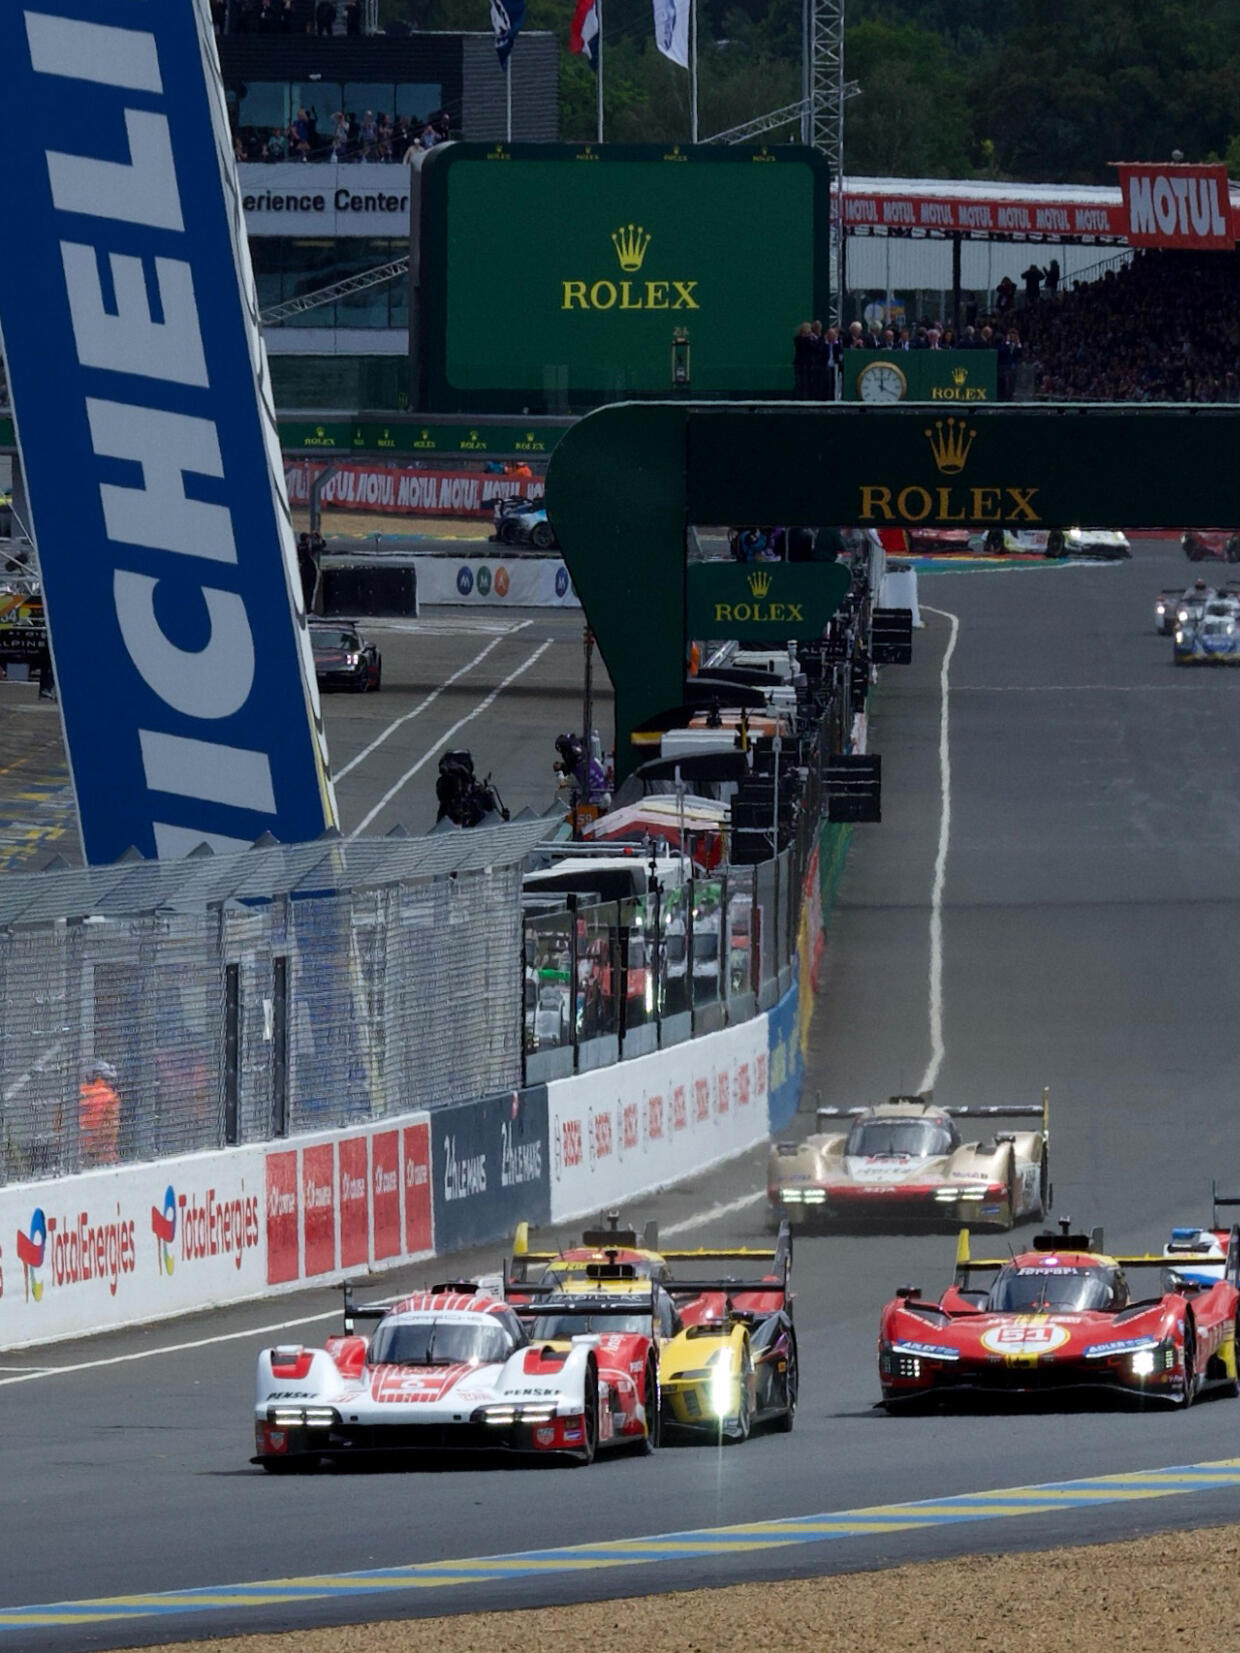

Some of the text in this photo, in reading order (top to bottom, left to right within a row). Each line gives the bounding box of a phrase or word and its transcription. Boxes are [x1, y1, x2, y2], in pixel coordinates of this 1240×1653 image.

[334, 189, 408, 212] Center
[1129, 175, 1226, 238] MOTUL
[845, 200, 1109, 232] MOTUL MOTUL MOTUL MOTUL MOTUL MOTUL MOTUL
[562, 280, 699, 310] ROLEX
[932, 386, 987, 400] ROLEX
[398, 475, 437, 509] MOTUL
[440, 477, 481, 510] MOTUL
[857, 486, 1040, 520] ROLEX
[714, 603, 803, 622] ROLEX
[179, 1178, 259, 1270] TotalEnergies
[48, 1202, 135, 1296] TotalEnergies
[1016, 1267, 1079, 1276] Ferrari
[1002, 1327, 1048, 1342] 51
[1088, 1341, 1126, 1352] ADLER
[266, 1391, 321, 1401] PENSKE
[504, 1388, 562, 1397] PENSKE
